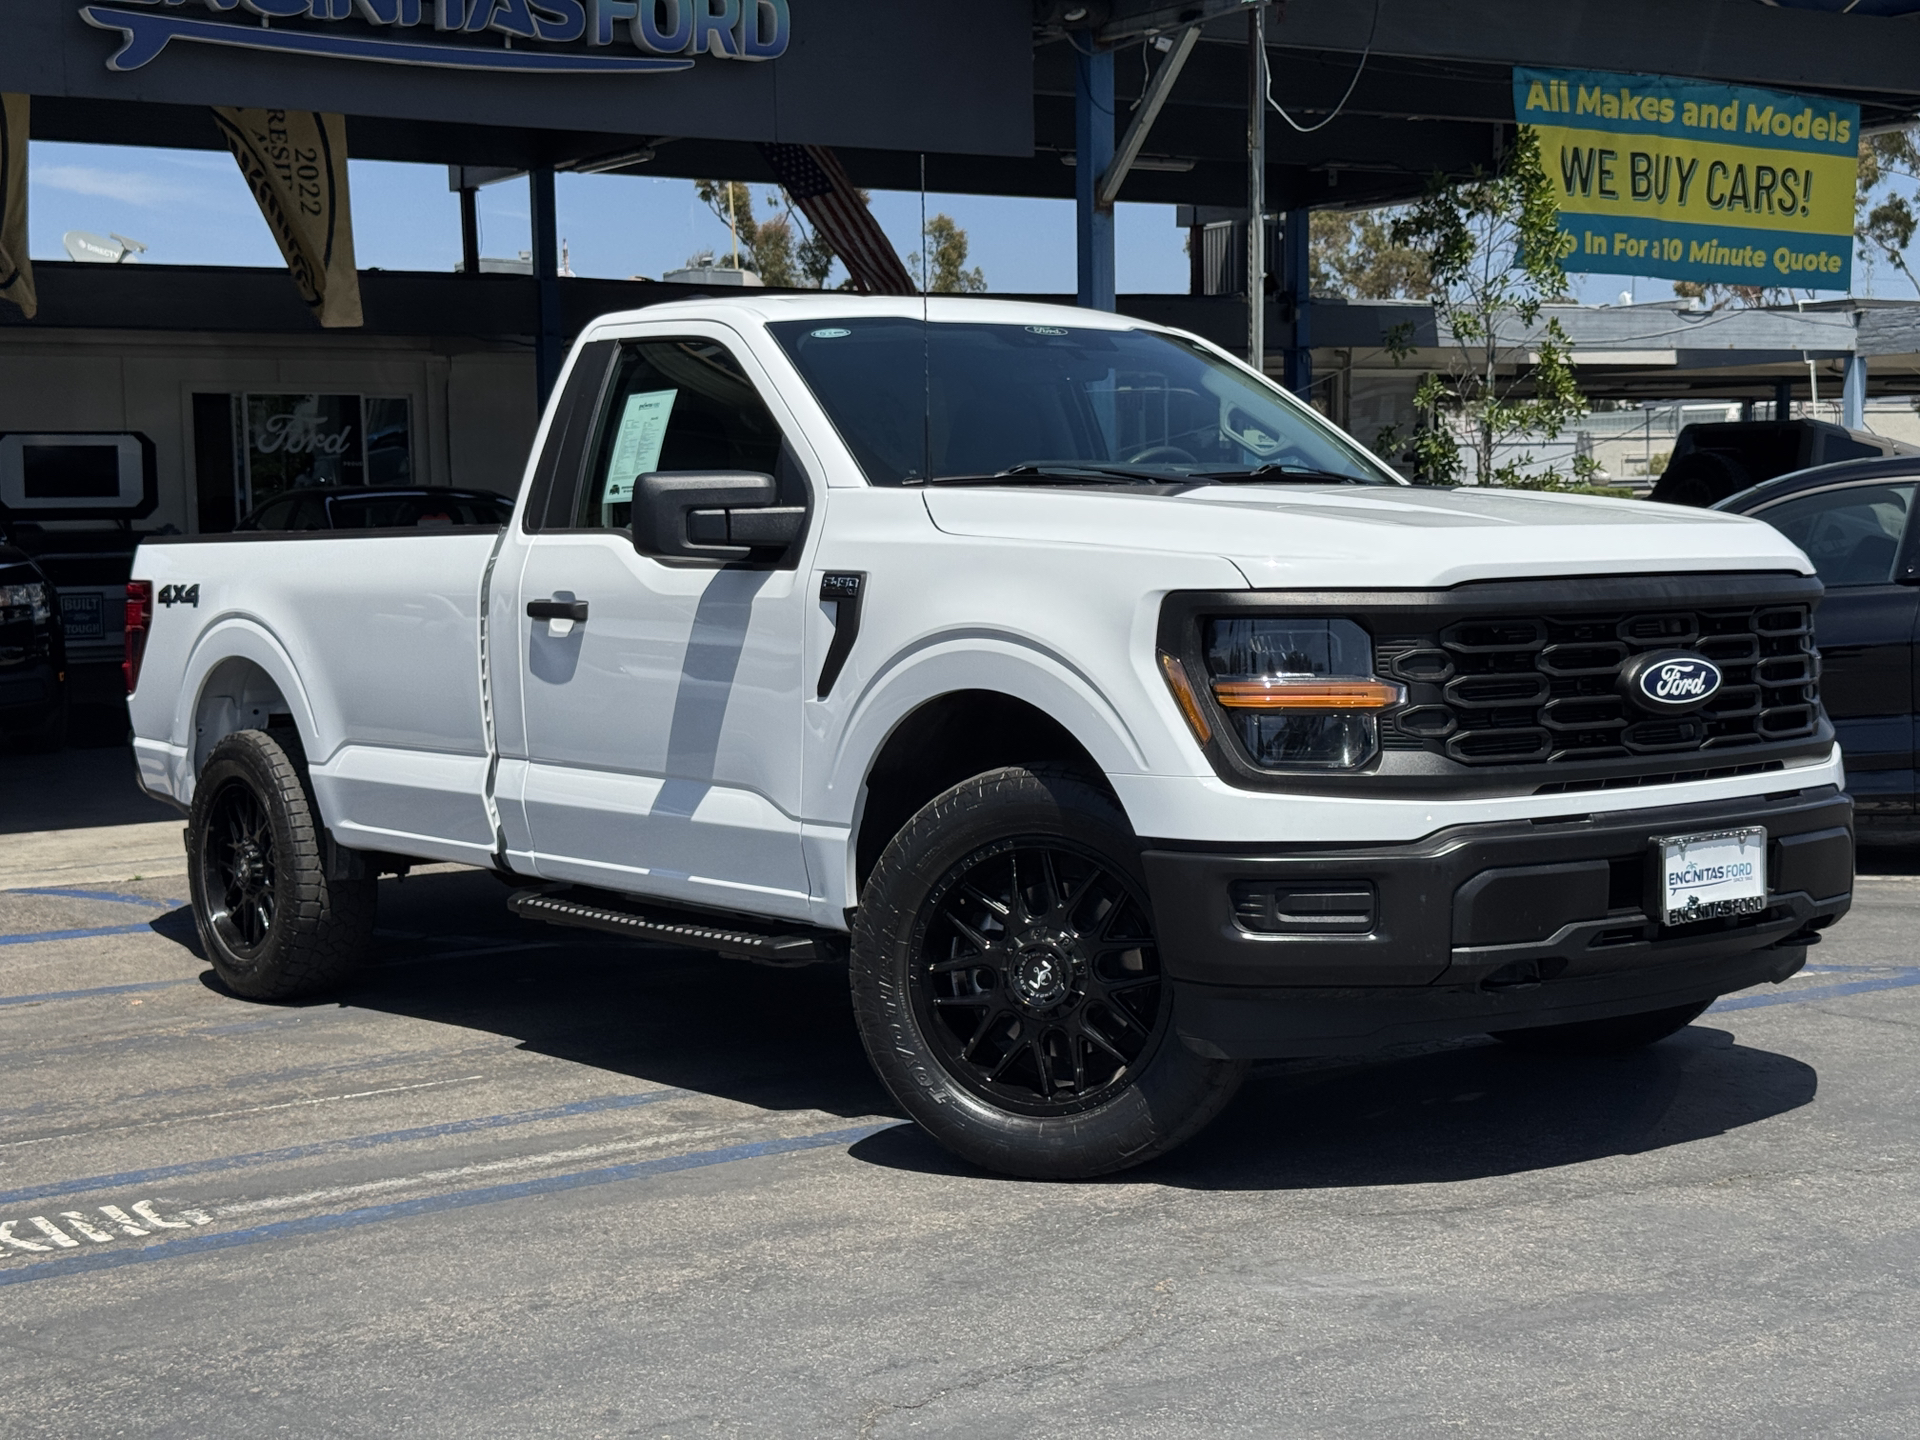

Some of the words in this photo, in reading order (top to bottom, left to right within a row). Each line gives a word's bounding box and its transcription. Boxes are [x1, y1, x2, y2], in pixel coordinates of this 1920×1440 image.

[1526, 80, 1570, 113] All
[1576, 83, 1675, 124] Makes
[1682, 99, 1739, 131] and
[1745, 103, 1850, 144] Models
[295, 147, 322, 218] 2022
[1561, 145, 1618, 199] WE
[1630, 151, 1699, 206] BUY
[1706, 160, 1813, 217] CARS!
[87, 243, 119, 259] DIRECTV
[1585, 230, 1607, 255] In
[1613, 232, 1648, 258] For
[1662, 238, 1683, 262] 10
[1688, 238, 1767, 268] Minute
[1773, 247, 1842, 275] Quote
[257, 414, 352, 453] Ford
[64, 598, 98, 611] BUILT
[64, 623, 99, 634] TOUGH
[1656, 664, 1706, 697] Ford
[1669, 864, 1725, 886] ENCINITAS
[1726, 862, 1753, 878] FORD
[1733, 896, 1762, 915] FORD
